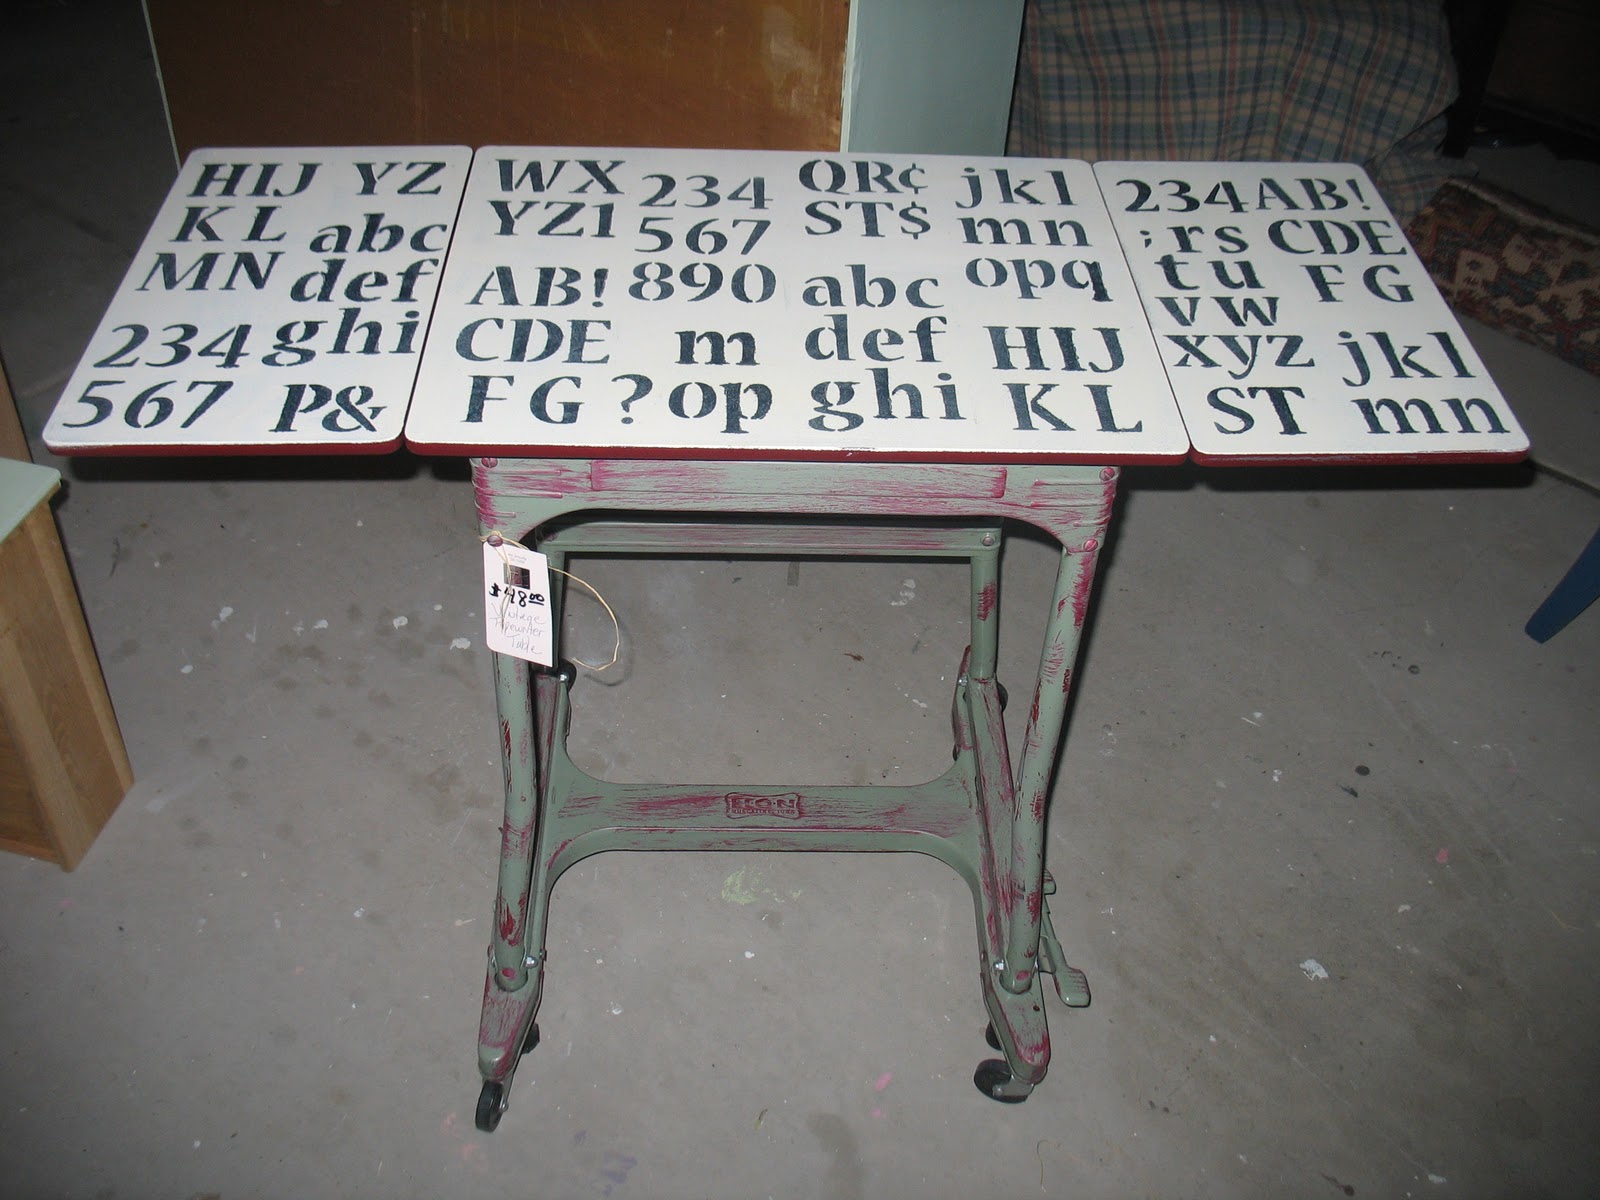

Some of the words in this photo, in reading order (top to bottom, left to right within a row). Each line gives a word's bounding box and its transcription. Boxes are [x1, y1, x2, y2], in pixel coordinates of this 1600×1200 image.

[187, 162, 322, 197] HIJ
[638, 174, 774, 209] 234
[309, 213, 448, 253] abc
[634, 216, 771, 255] 567
[290, 258, 440, 303] def
[628, 262, 776, 303] 890
[802, 264, 945, 309] abc
[93, 323, 252, 369] 234
[261, 307, 421, 367] ghi
[455, 317, 612, 364] CDE
[804, 313, 948, 363] def
[983, 326, 1125, 373] HIJ
[62, 380, 234, 429] 567
[808, 367, 967, 432] ghi
